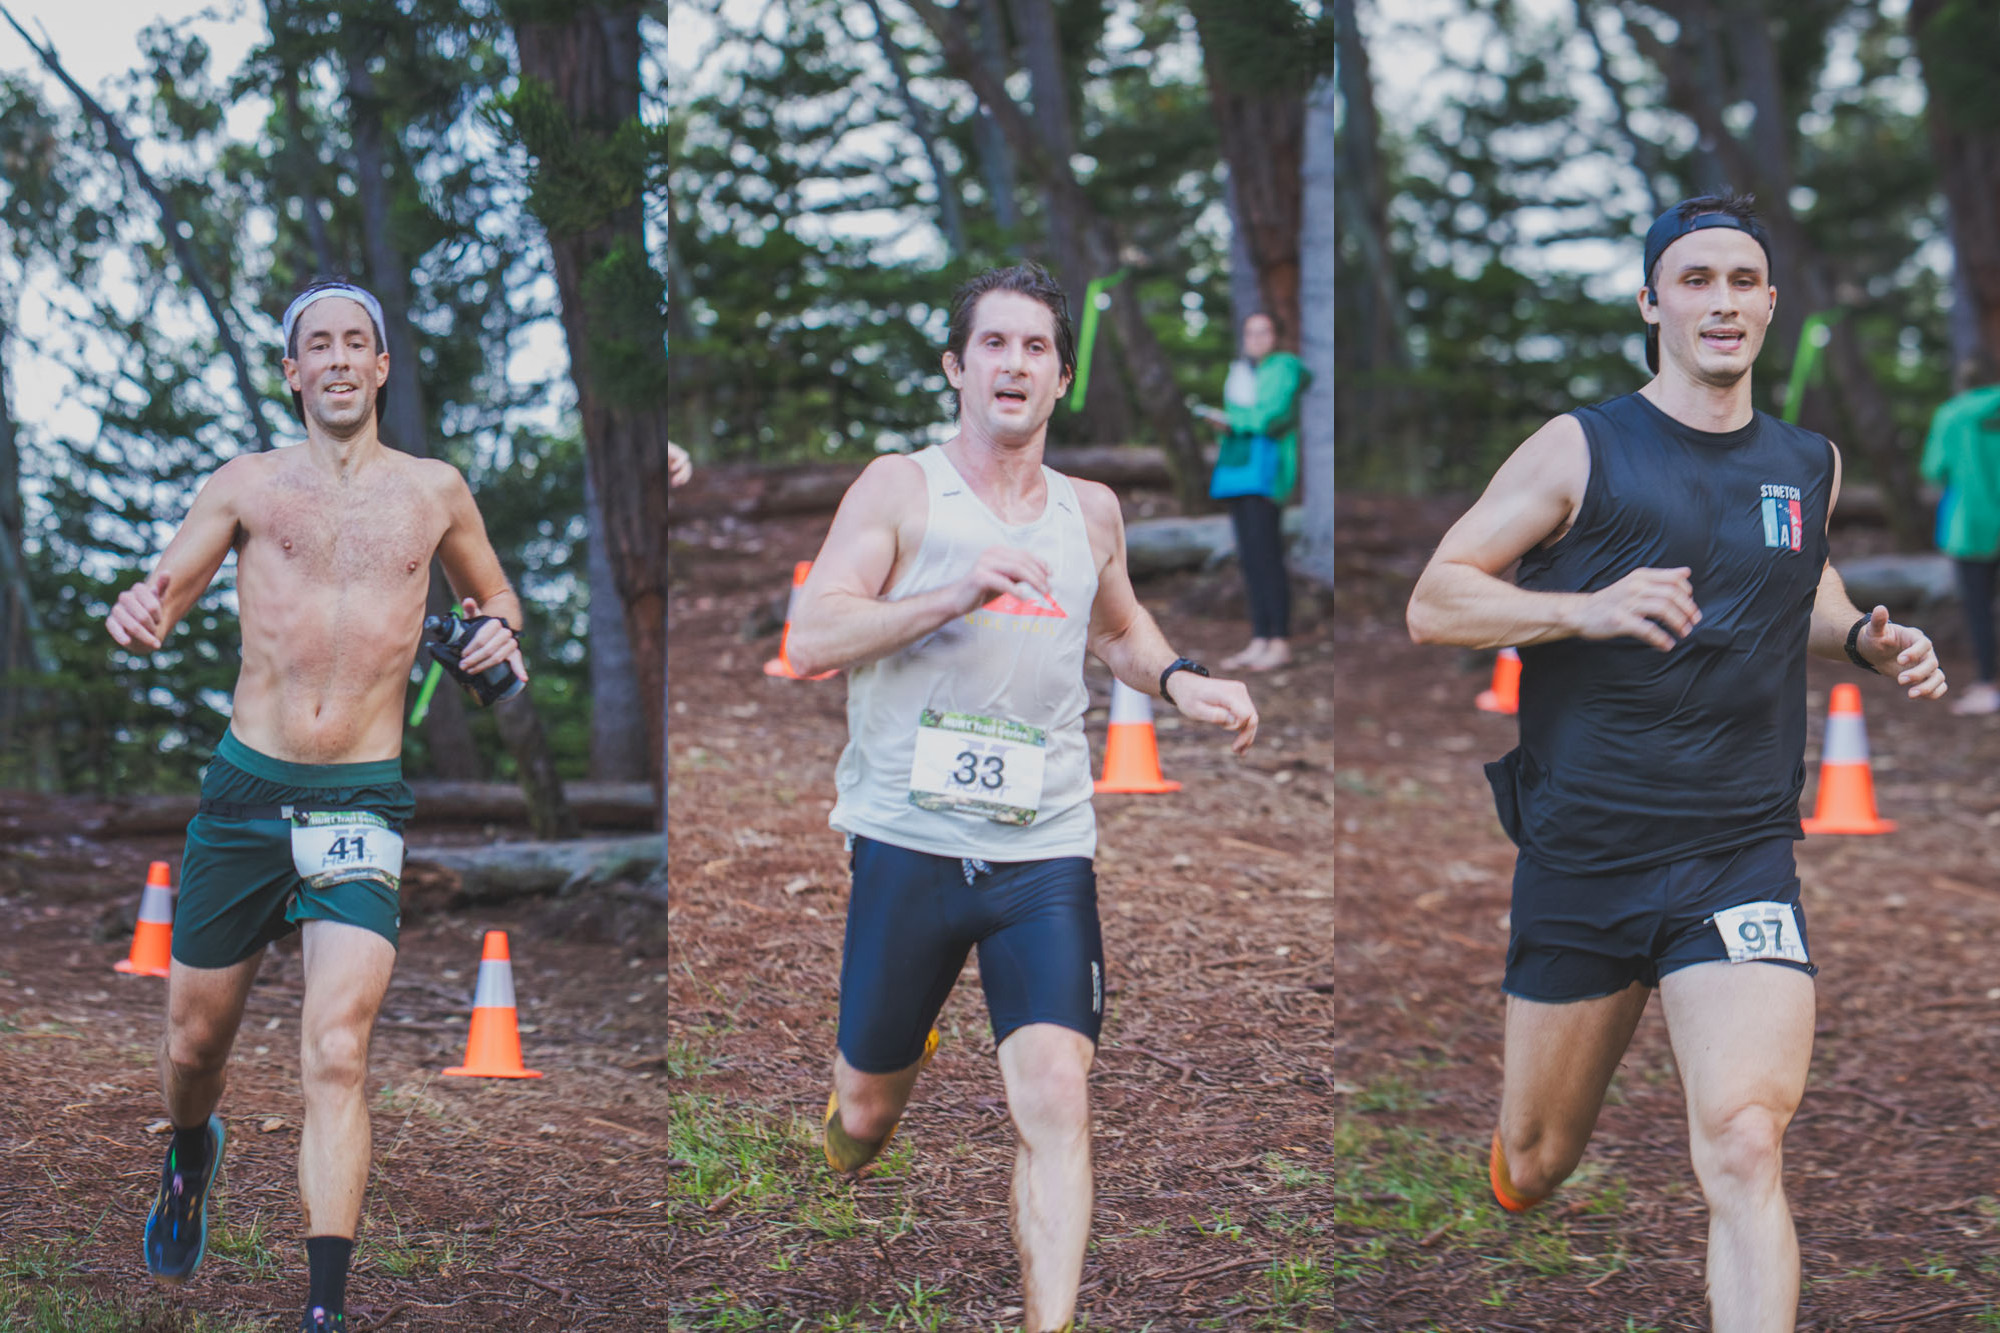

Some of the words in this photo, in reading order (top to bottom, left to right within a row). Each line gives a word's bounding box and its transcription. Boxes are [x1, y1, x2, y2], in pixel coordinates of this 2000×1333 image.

[1760, 485, 1800, 501] STRETCH
[1768, 523, 1800, 548] LAB
[953, 751, 1004, 789] 33
[327, 836, 364, 859] 41
[1738, 919, 1783, 952] 97
